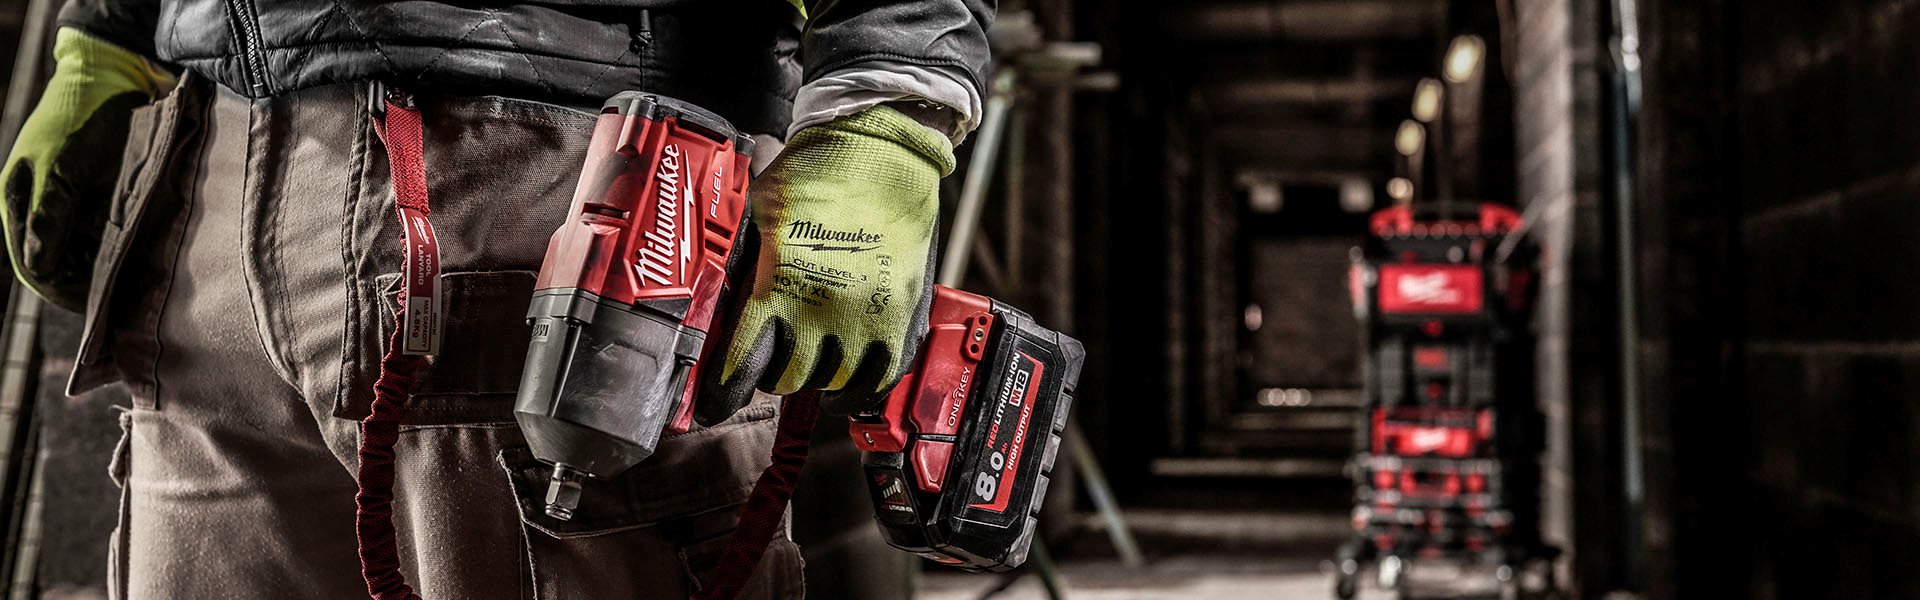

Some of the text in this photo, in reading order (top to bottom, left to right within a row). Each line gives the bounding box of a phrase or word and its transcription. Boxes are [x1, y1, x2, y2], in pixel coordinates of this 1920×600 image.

[710, 166, 723, 218] FUEL
[634, 143, 681, 286] Milwaukee
[787, 219, 881, 243] Milwaukee
[793, 258, 867, 282] CUT LEVEL 3
[811, 286, 830, 300] XL
[1010, 370, 1028, 406] M18
[1007, 404, 1031, 470] HIGH OUTPUT
[975, 442, 1008, 501] 8.0 Ah
